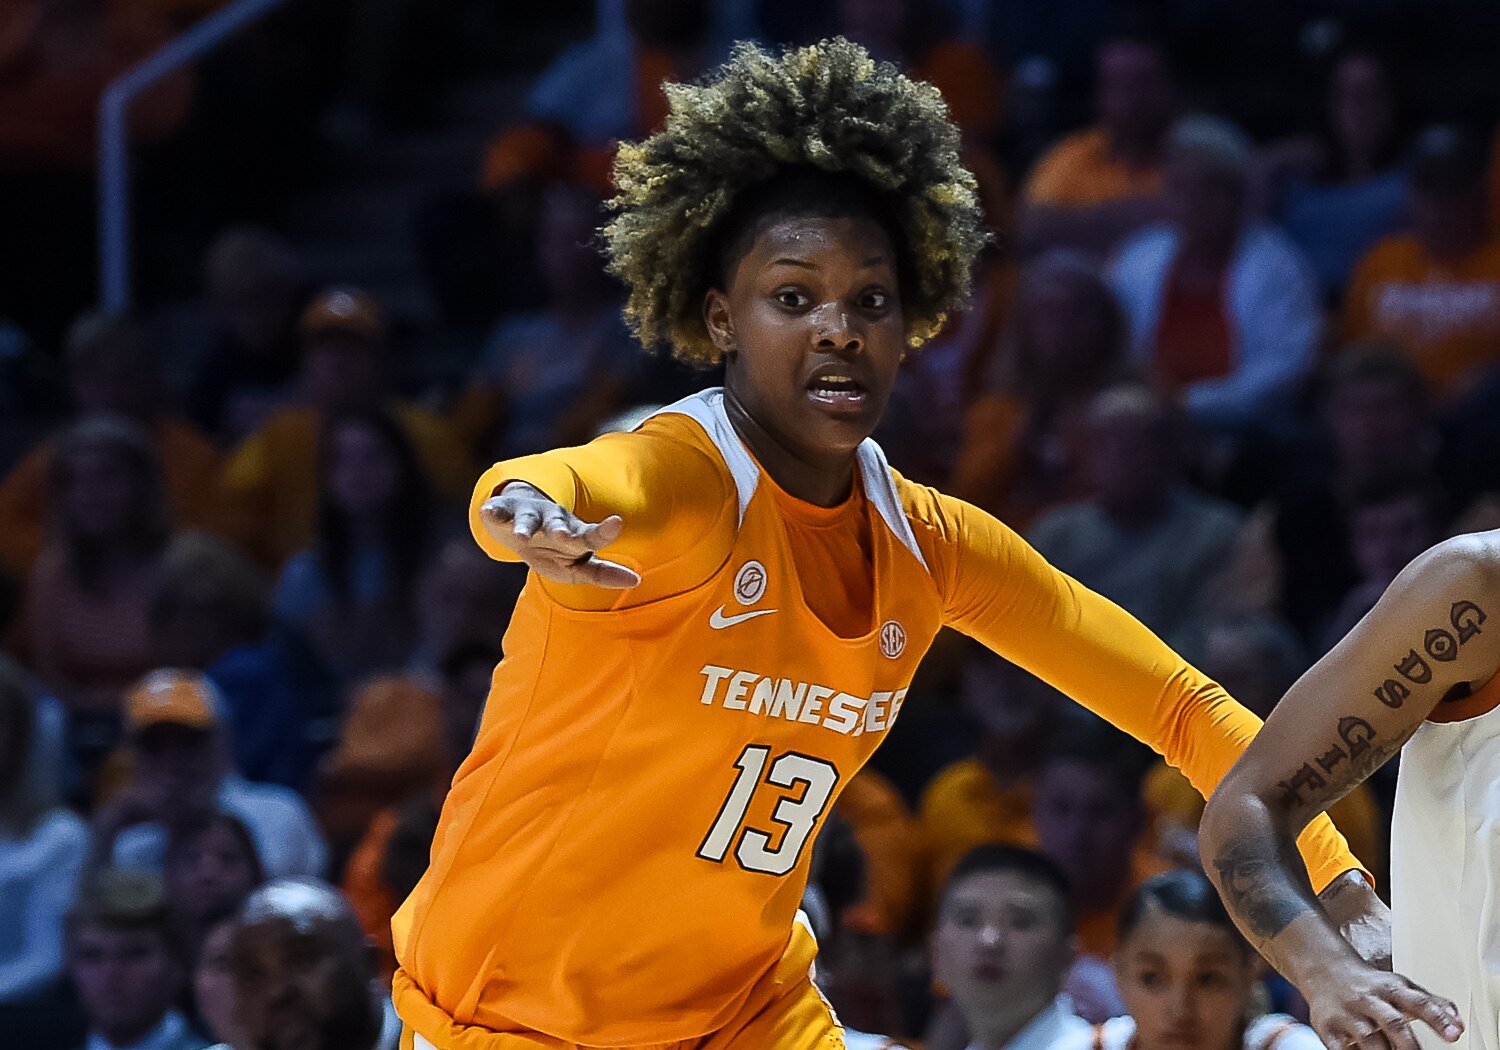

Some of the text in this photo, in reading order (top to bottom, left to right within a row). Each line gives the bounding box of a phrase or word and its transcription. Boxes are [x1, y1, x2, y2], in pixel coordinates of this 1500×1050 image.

[700, 664, 908, 737] TENNESEE
[1373, 600, 1488, 708] GODS
[696, 744, 839, 876] 13
